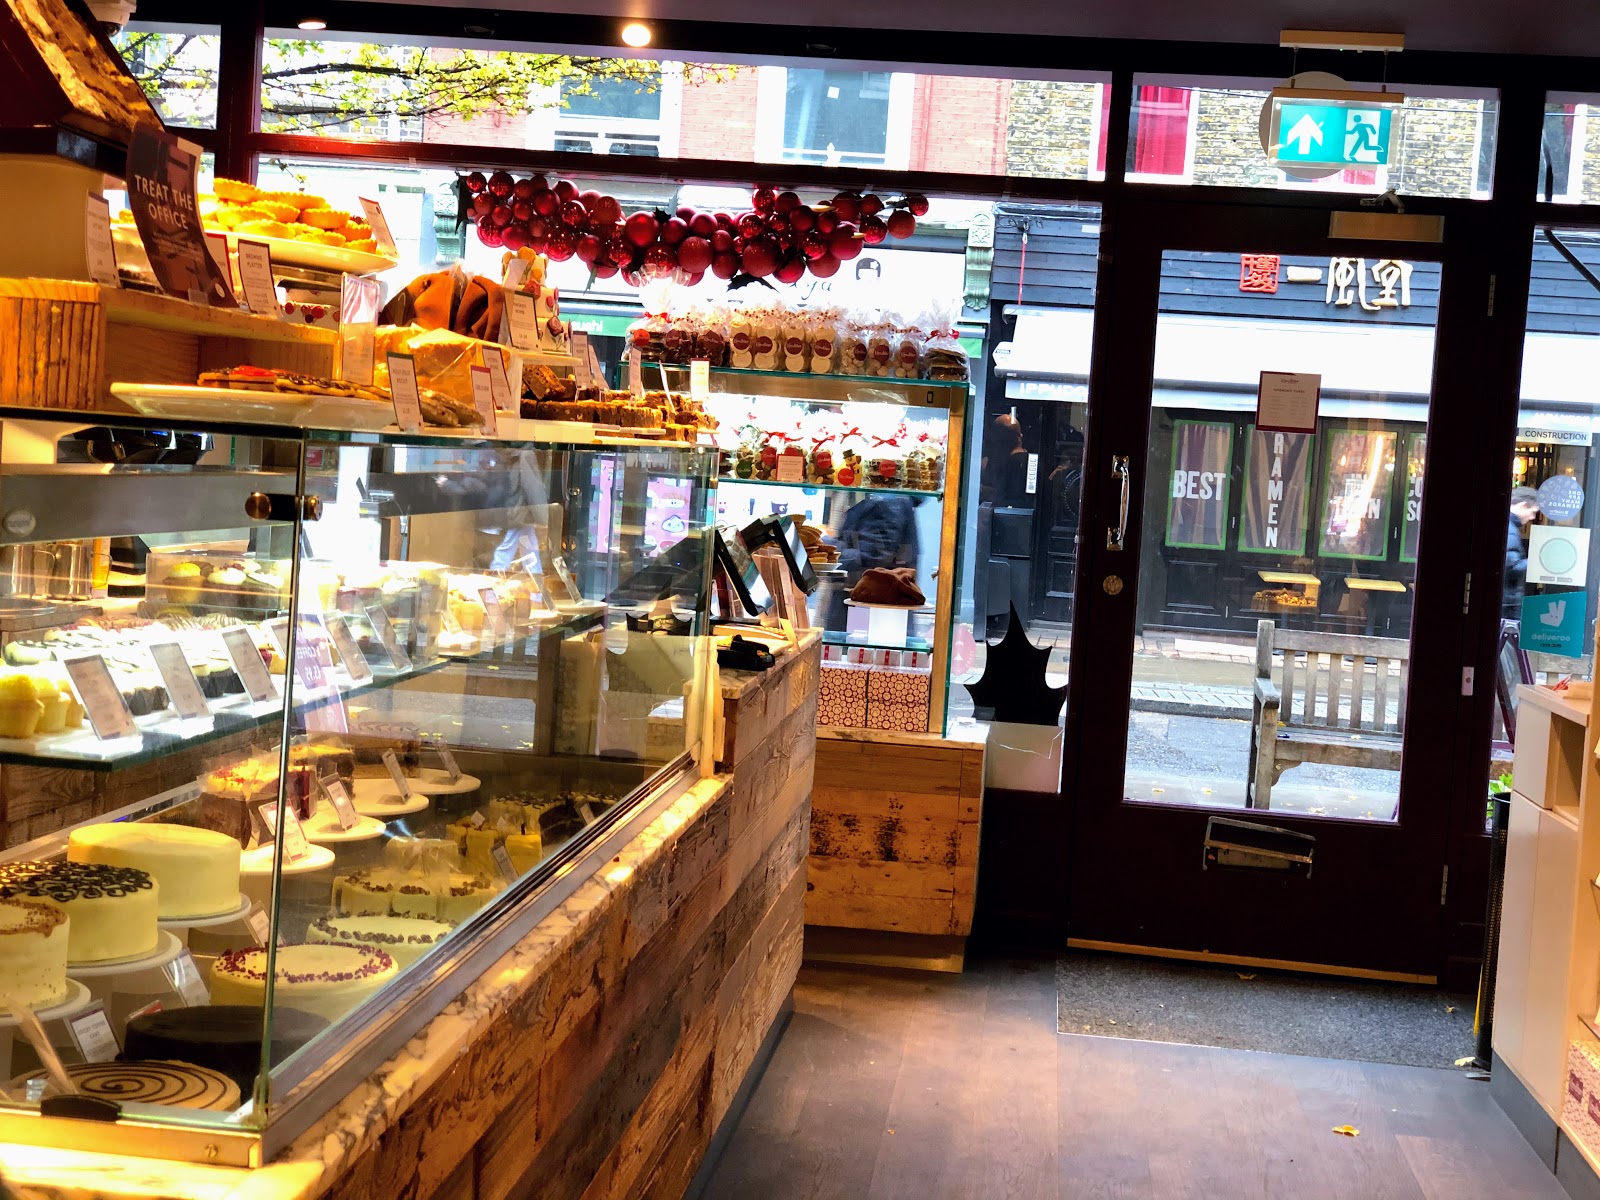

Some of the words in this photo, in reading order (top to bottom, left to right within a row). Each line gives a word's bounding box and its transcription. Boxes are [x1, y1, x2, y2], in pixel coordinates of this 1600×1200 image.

[134, 174, 170, 204] TREAT
[172, 191, 194, 211] THE
[148, 203, 189, 230] OFFICE
[1525, 430, 1588, 441] CONSTRUCTION
[1172, 469, 1226, 500] BEST
[1265, 433, 1284, 548] RAMEN
[1531, 633, 1571, 642] deliveroo
